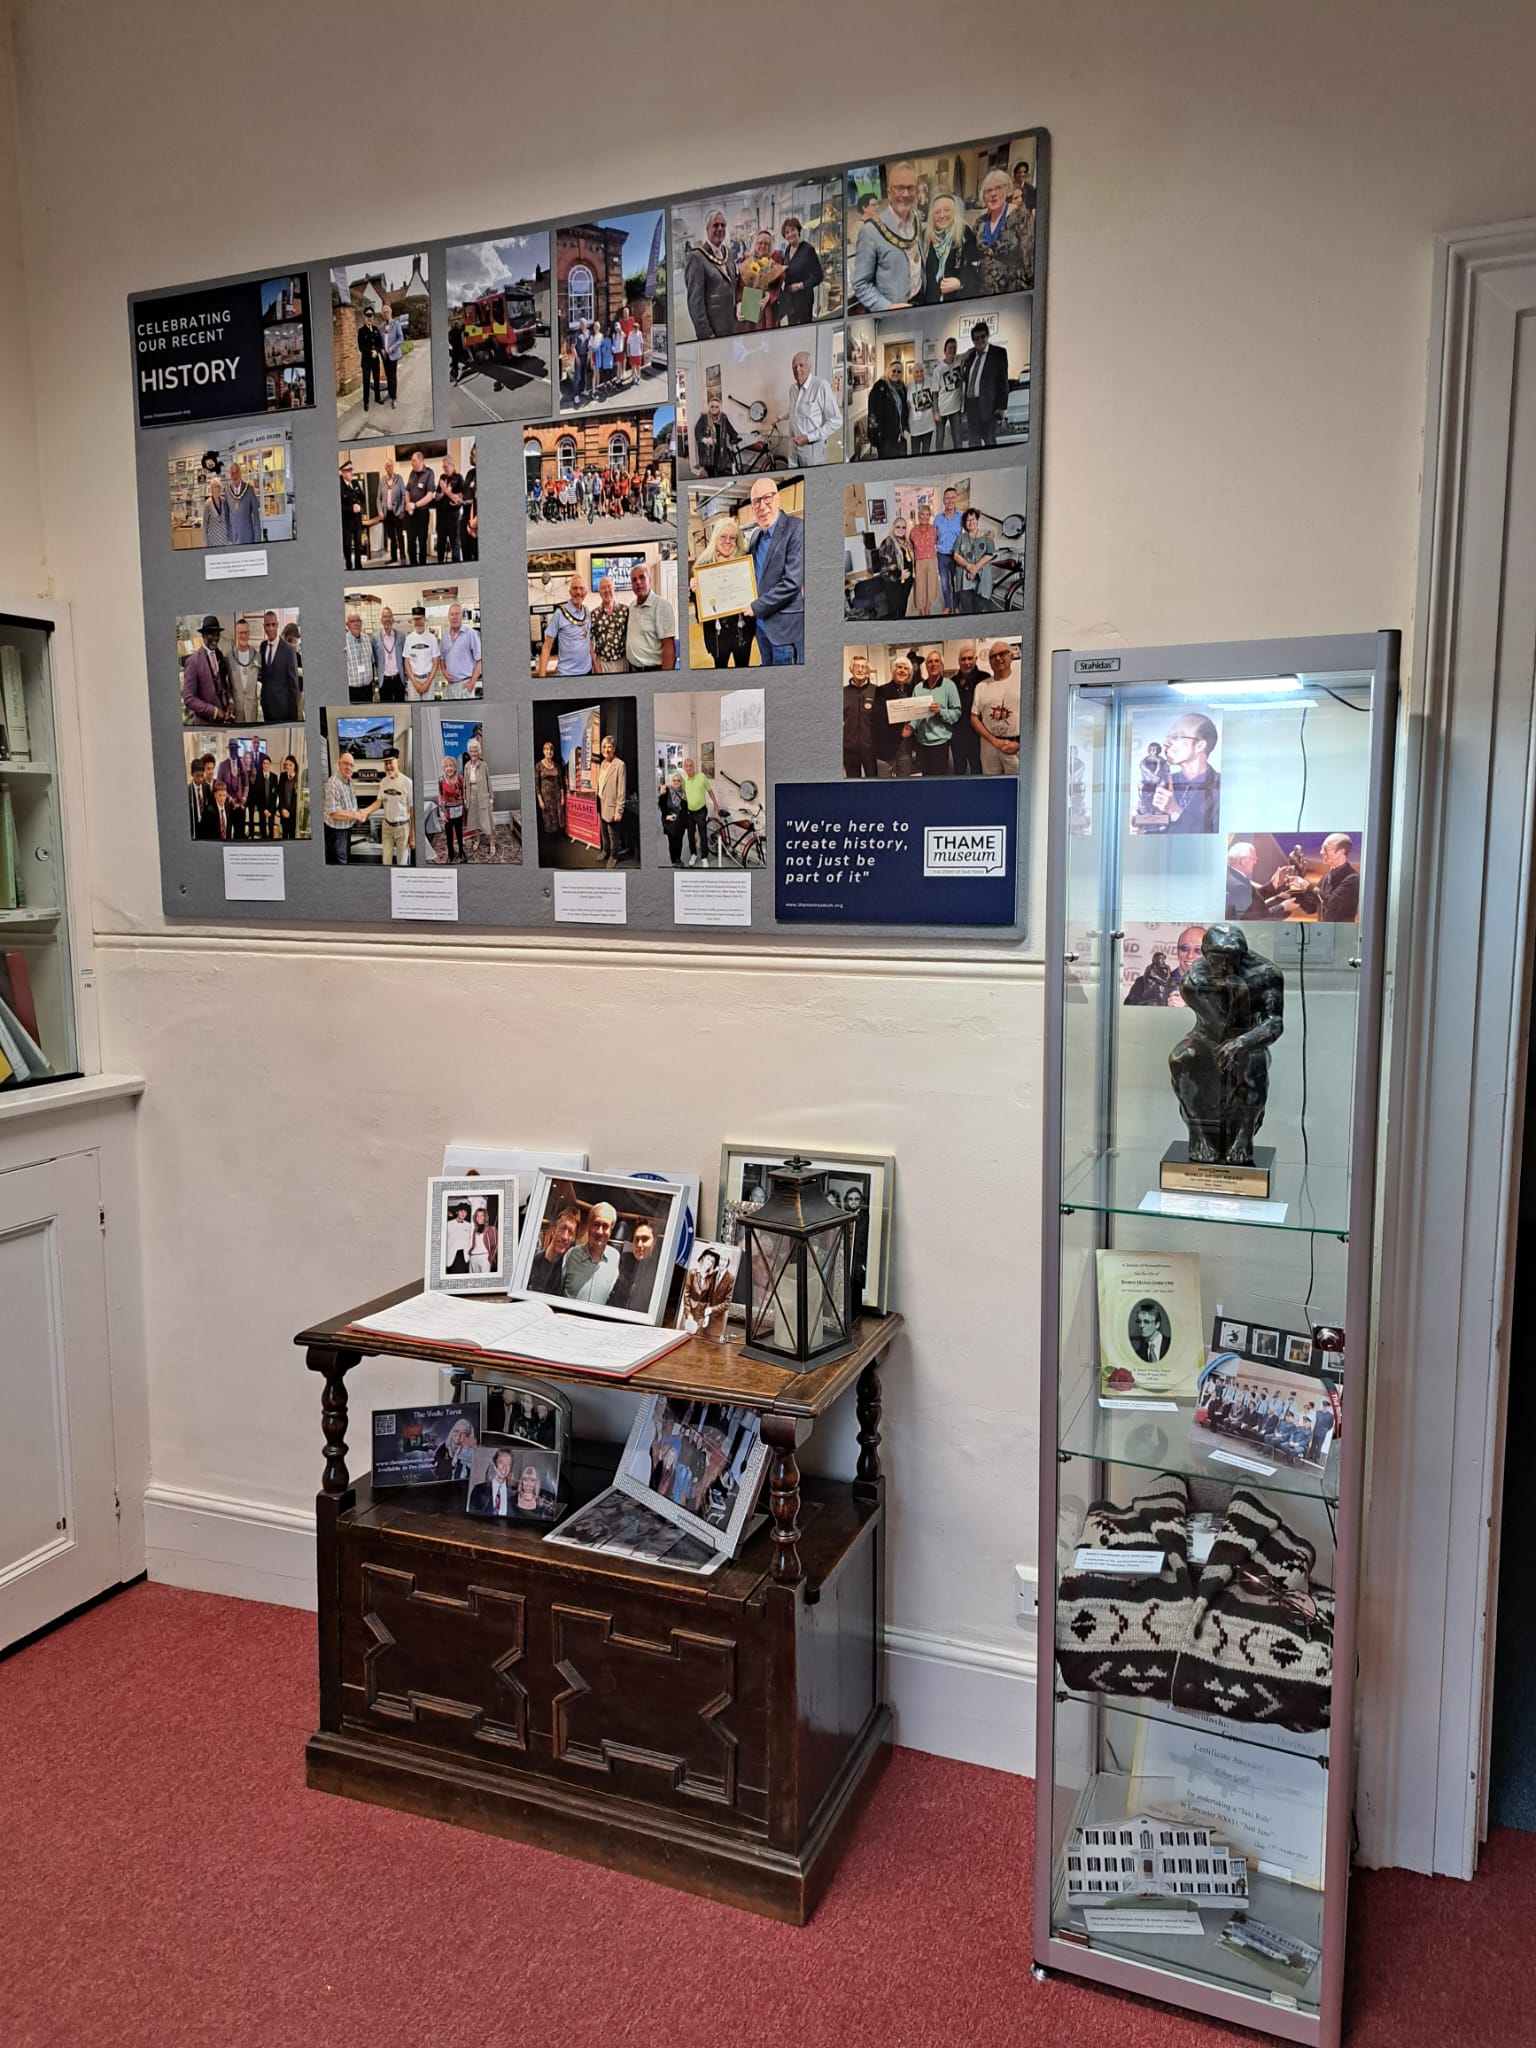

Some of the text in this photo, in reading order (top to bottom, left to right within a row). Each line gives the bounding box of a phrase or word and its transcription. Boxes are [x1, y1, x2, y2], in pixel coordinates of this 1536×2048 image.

[137, 309, 232, 336] CELEBRATING
[138, 328, 225, 353] OUR RECENT
[141, 356, 240, 393] HISTORY
[568, 801, 595, 815] THAME
[785, 819, 910, 833] "We're here to
[785, 836, 908, 852] create history,
[933, 835, 996, 850] THAME
[785, 854, 876, 869] not just be
[933, 851, 996, 862] museum
[785, 870, 870, 886] part of it"
[1193, 1743, 1230, 1762] Certificate
[1187, 1802, 1217, 1818] Lancaster
[1196, 1792, 1232, 1812] undertaking
